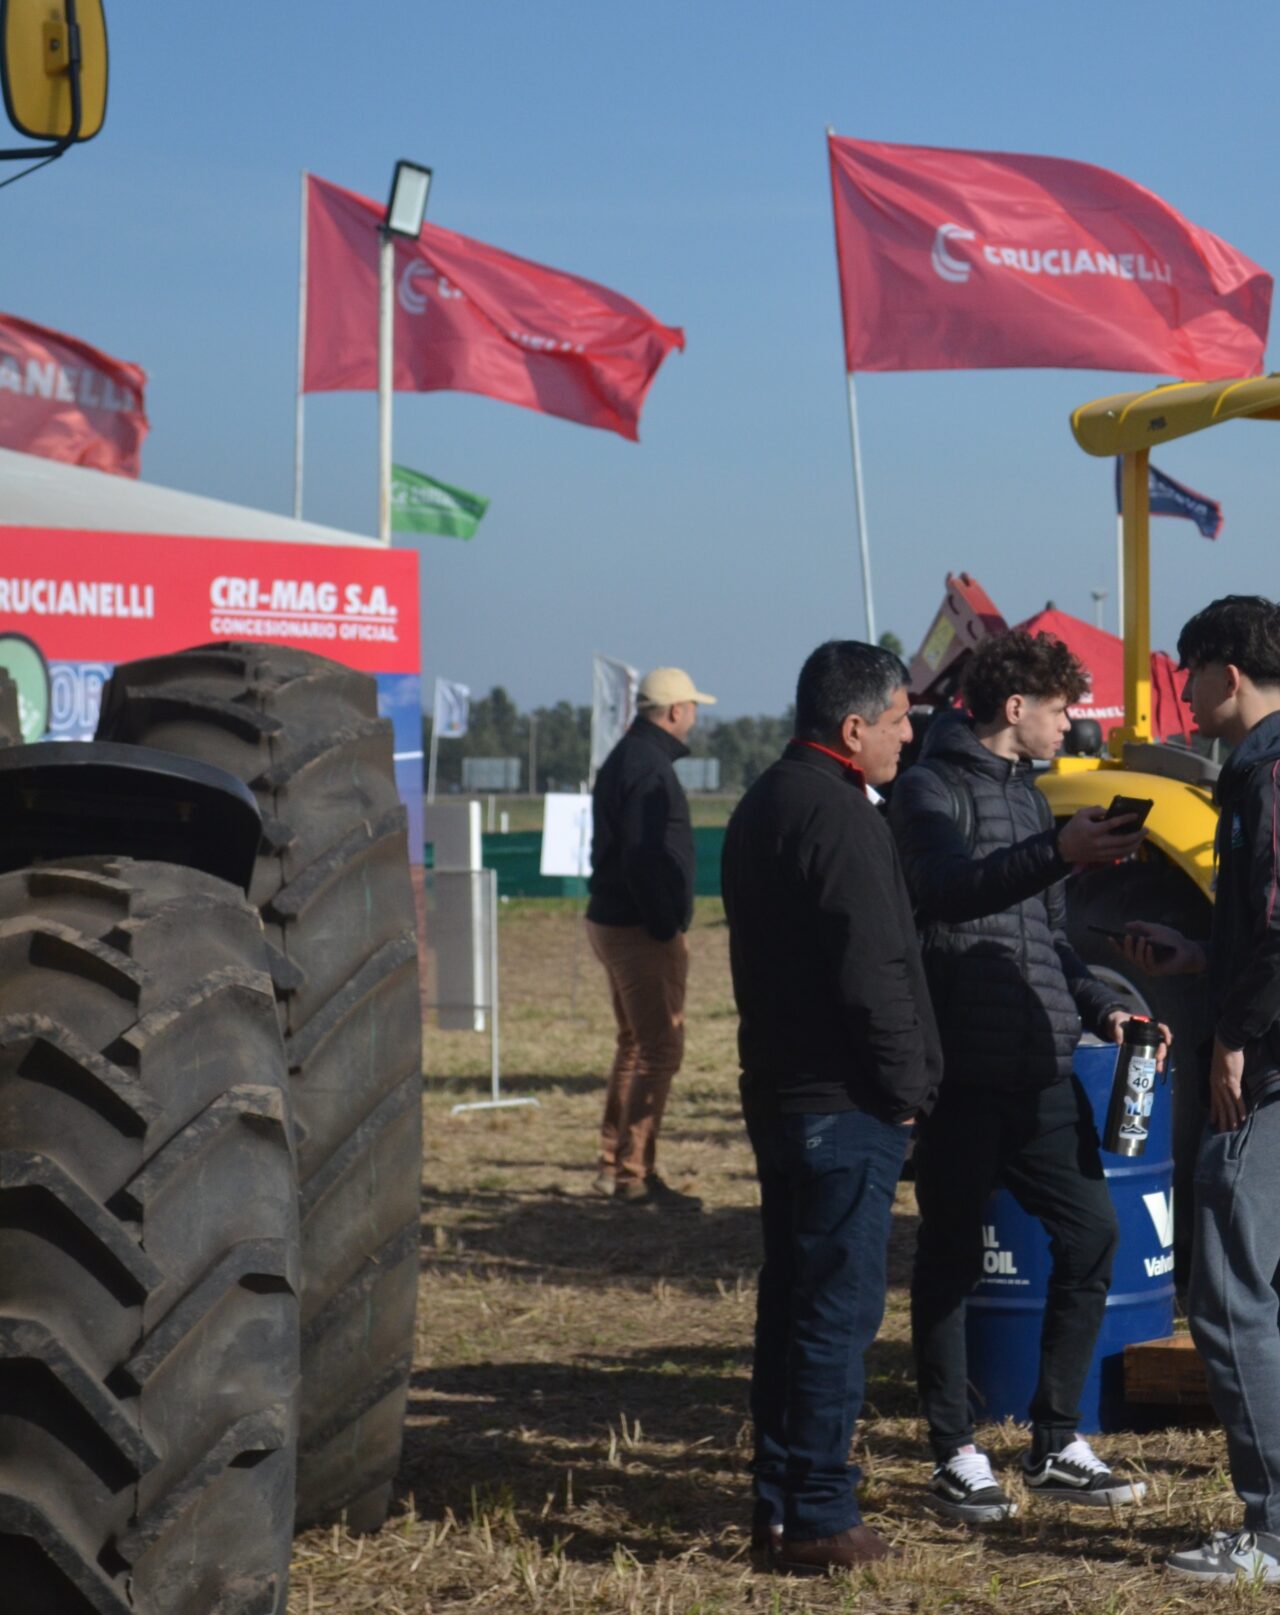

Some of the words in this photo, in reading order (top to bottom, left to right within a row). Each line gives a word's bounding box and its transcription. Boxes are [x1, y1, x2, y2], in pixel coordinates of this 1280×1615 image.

[983, 245, 1171, 283] CRUCIANELLI
[210, 575, 338, 613] CRI-MAG
[344, 583, 398, 616] S.A.
[210, 617, 336, 639] CONCESIONARIO
[1132, 1078, 1149, 1089] 40
